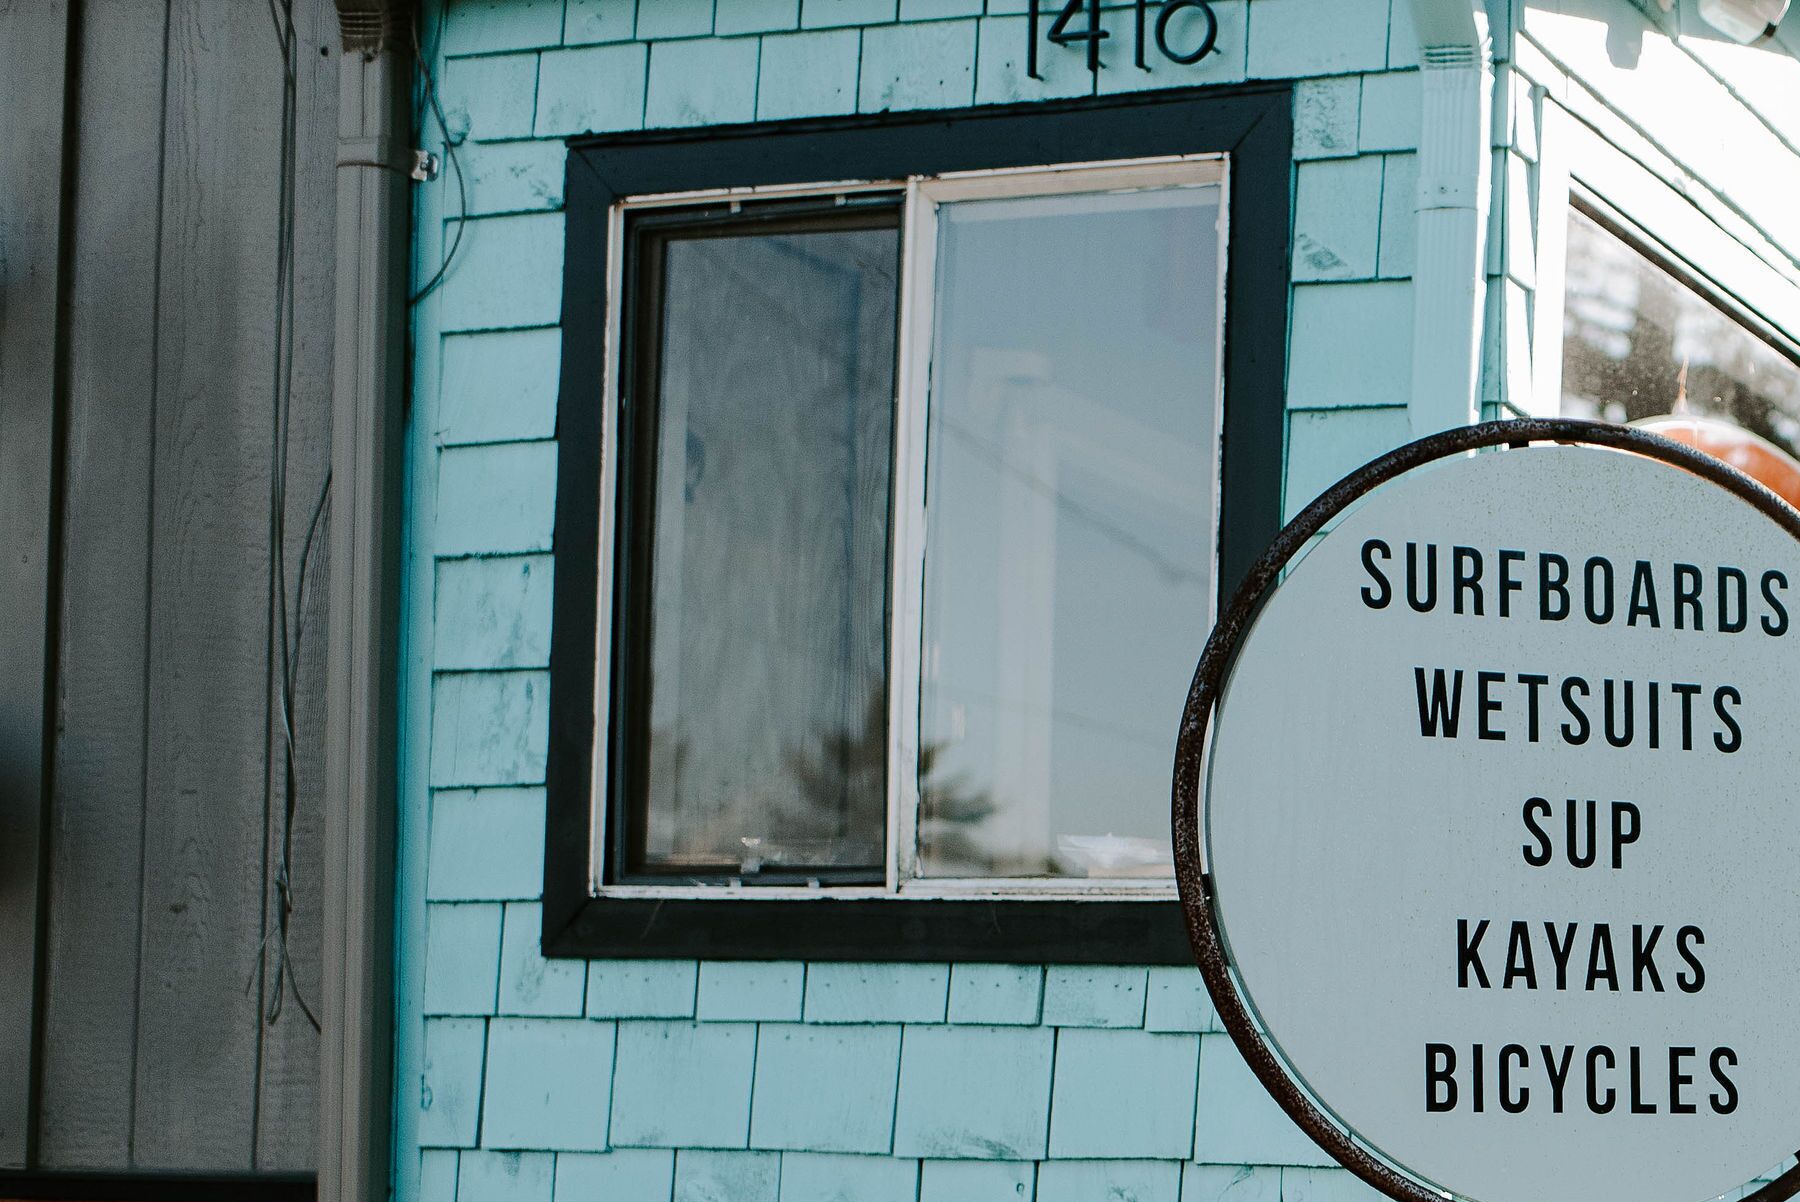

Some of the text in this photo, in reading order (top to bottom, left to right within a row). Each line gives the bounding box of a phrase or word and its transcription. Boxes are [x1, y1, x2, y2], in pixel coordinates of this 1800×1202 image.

[1360, 538, 1789, 637] SURFBOARDS
[1413, 666, 1743, 754] WETSUITS
[1522, 796, 1641, 870] SUP
[1456, 918, 1706, 994] KAYAKS
[1425, 1042, 1739, 1115] BICYCLES
